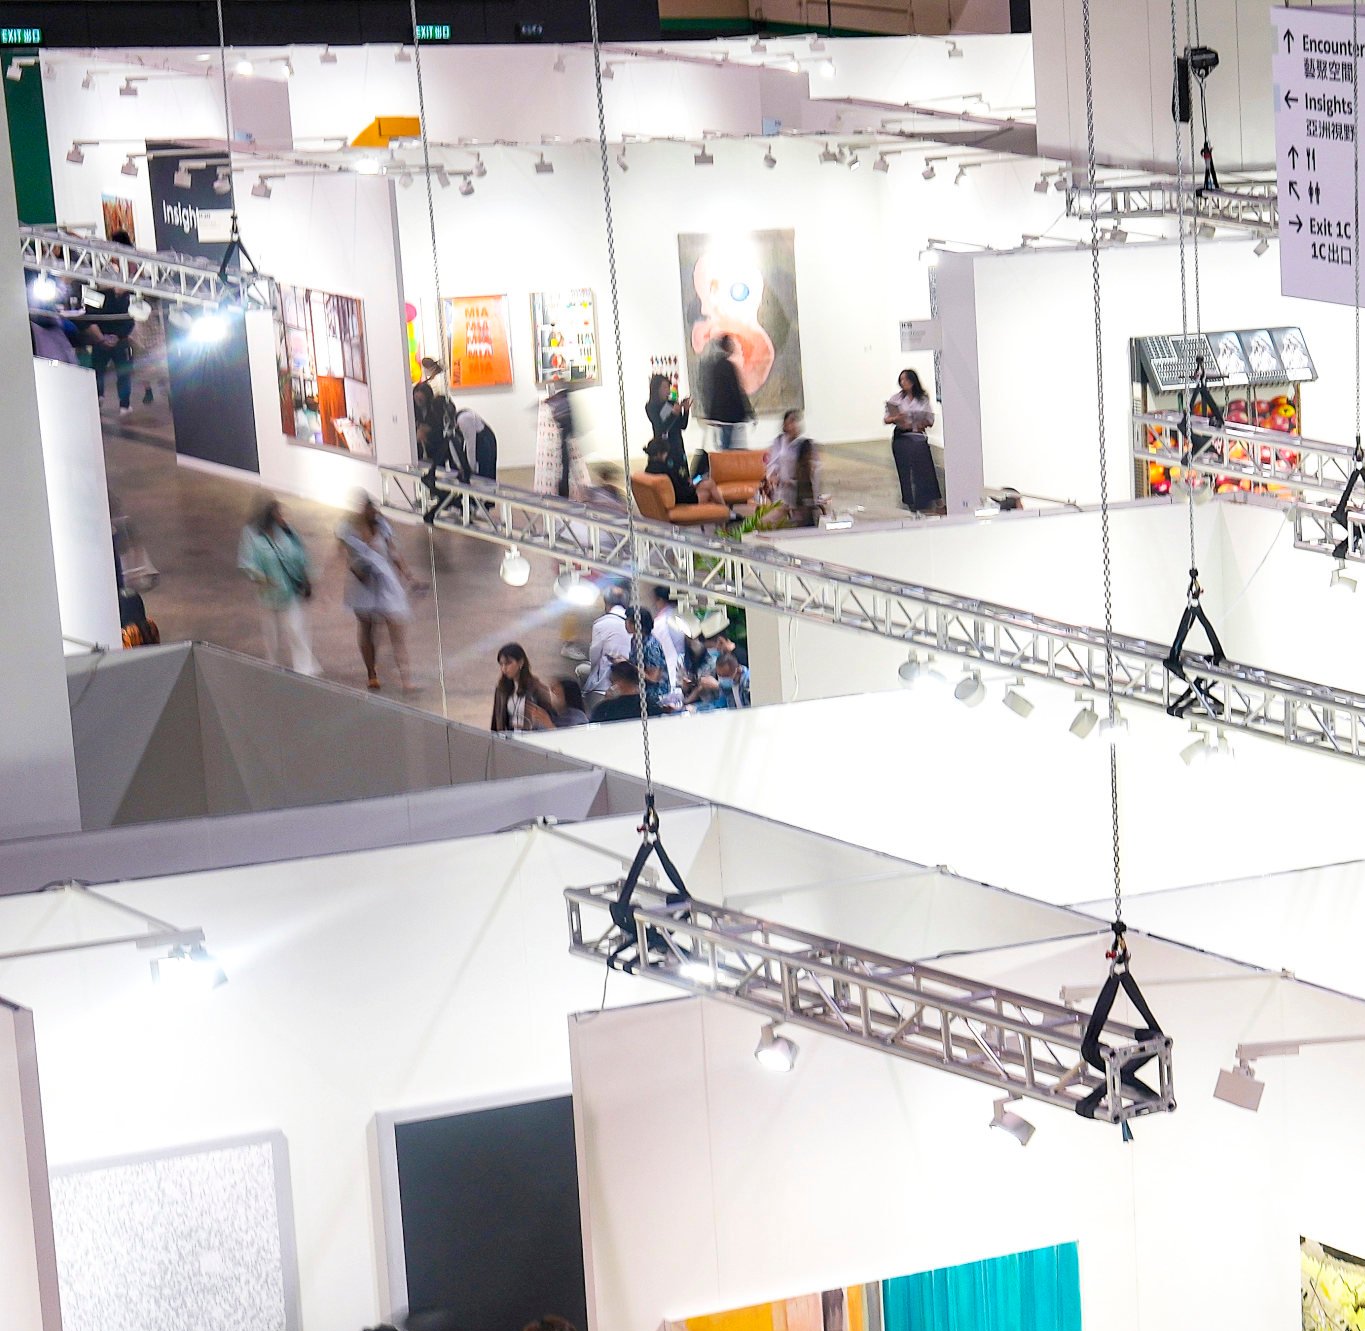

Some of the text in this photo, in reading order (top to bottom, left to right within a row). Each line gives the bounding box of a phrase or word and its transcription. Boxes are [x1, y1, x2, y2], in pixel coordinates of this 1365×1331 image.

[2, 29, 21, 43] EXIT
[1303, 57, 1353, 83] 藝聚空間
[1305, 92, 1353, 117] Insights
[1306, 119, 1355, 142] 亞洲視野
[1310, 217, 1352, 240] Exit 1C
